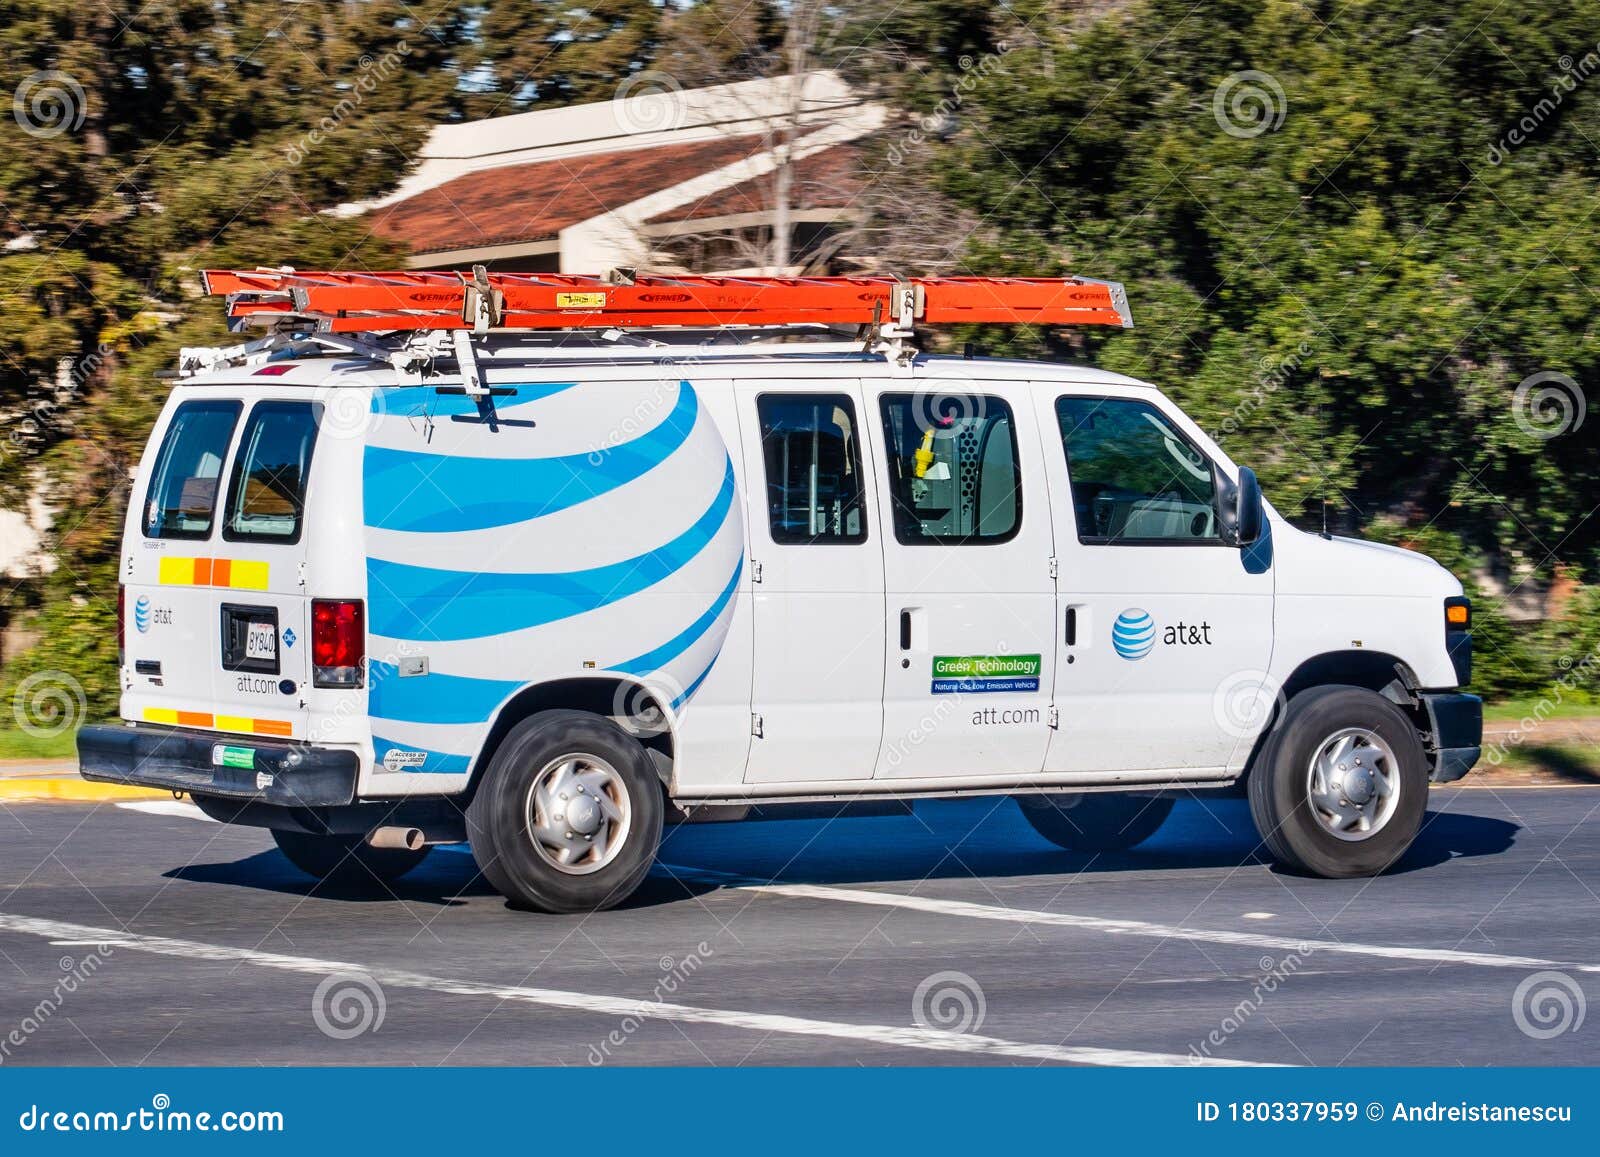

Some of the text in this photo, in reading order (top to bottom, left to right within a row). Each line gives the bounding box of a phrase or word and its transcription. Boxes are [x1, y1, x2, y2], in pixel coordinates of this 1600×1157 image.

[153, 607, 172, 625] at&t
[249, 631, 276, 653] 8Y840
[1163, 621, 1212, 645] at&t
[936, 659, 1037, 674] Green Technology
[237, 675, 278, 694] att.com
[1015, 681, 1036, 689] Vehicle
[972, 708, 1040, 725] att.com
